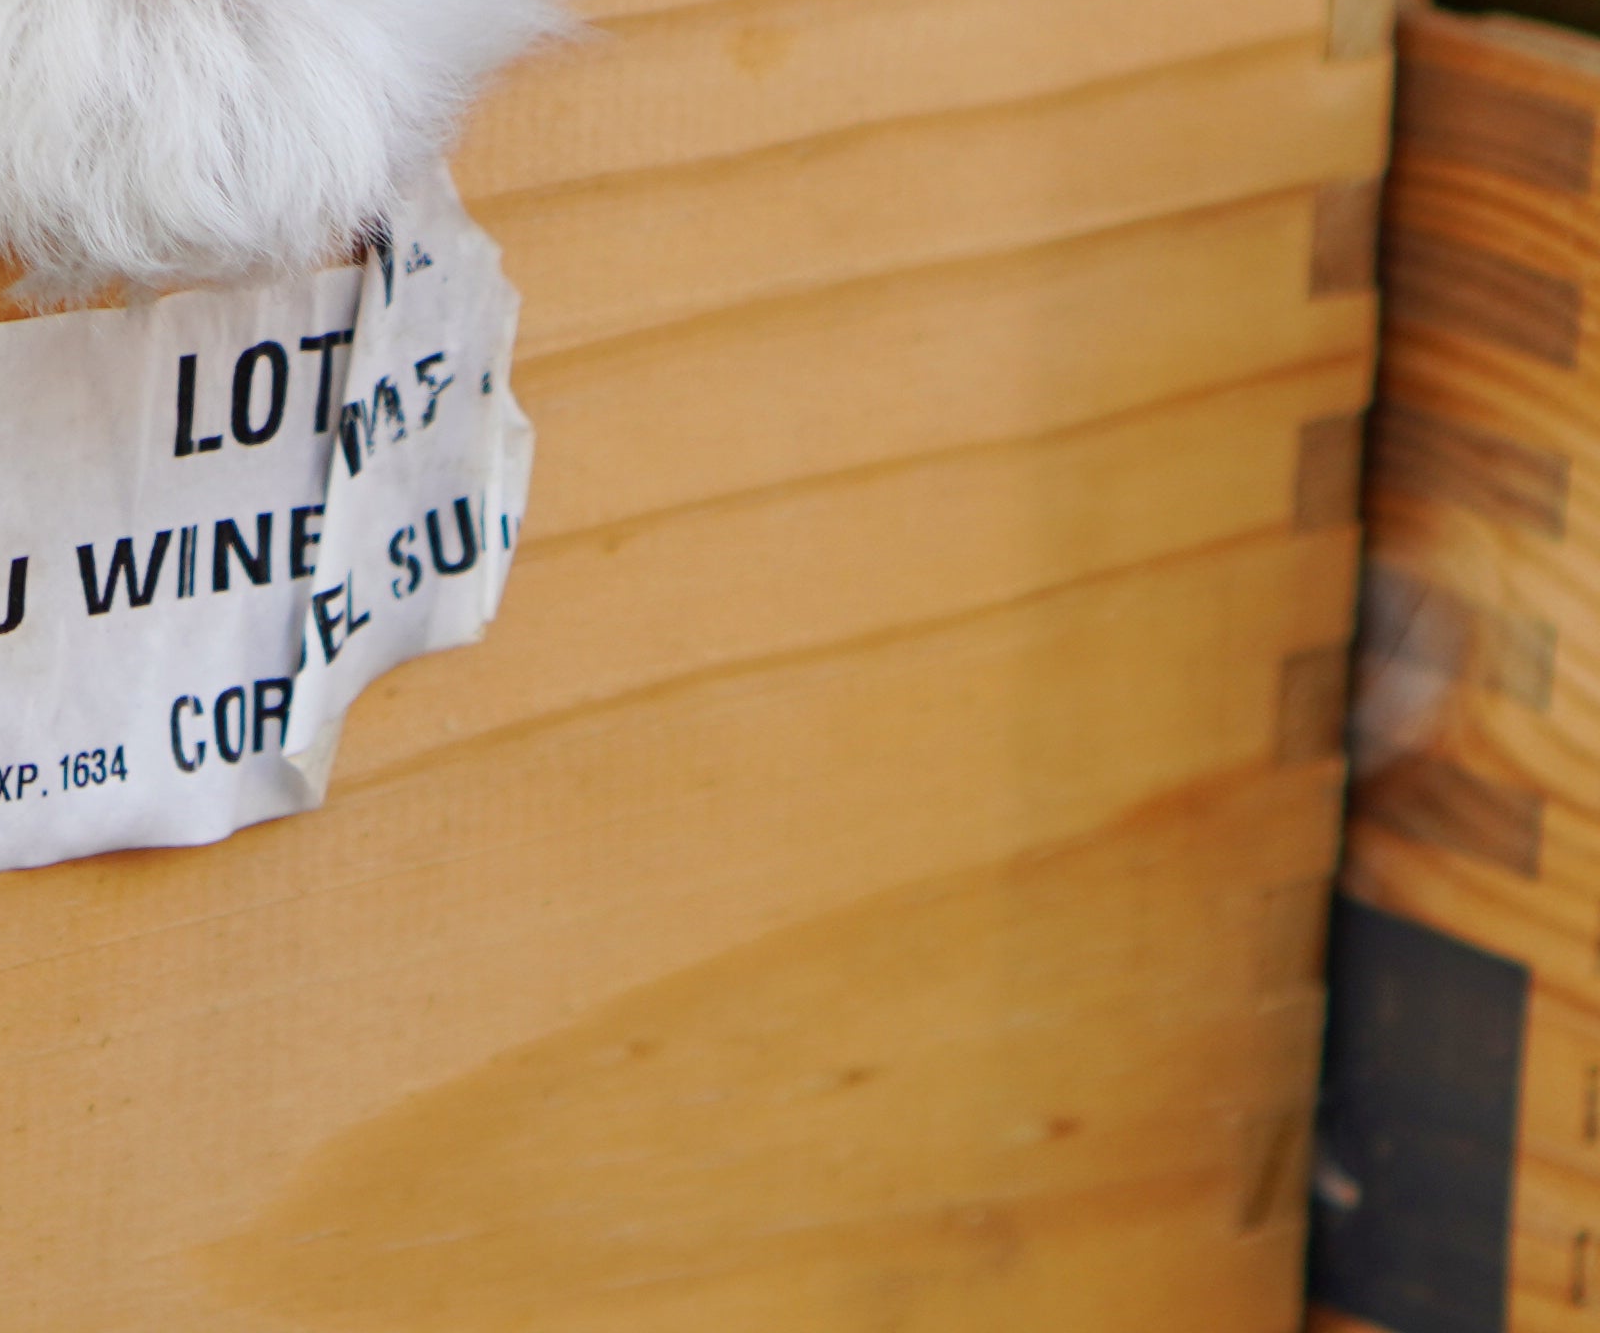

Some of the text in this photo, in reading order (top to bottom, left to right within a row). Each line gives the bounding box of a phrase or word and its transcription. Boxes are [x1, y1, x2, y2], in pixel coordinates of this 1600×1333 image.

[174, 328, 354, 457] LOT
[76, 503, 326, 616] WINE
[59, 744, 128, 791] 1634
